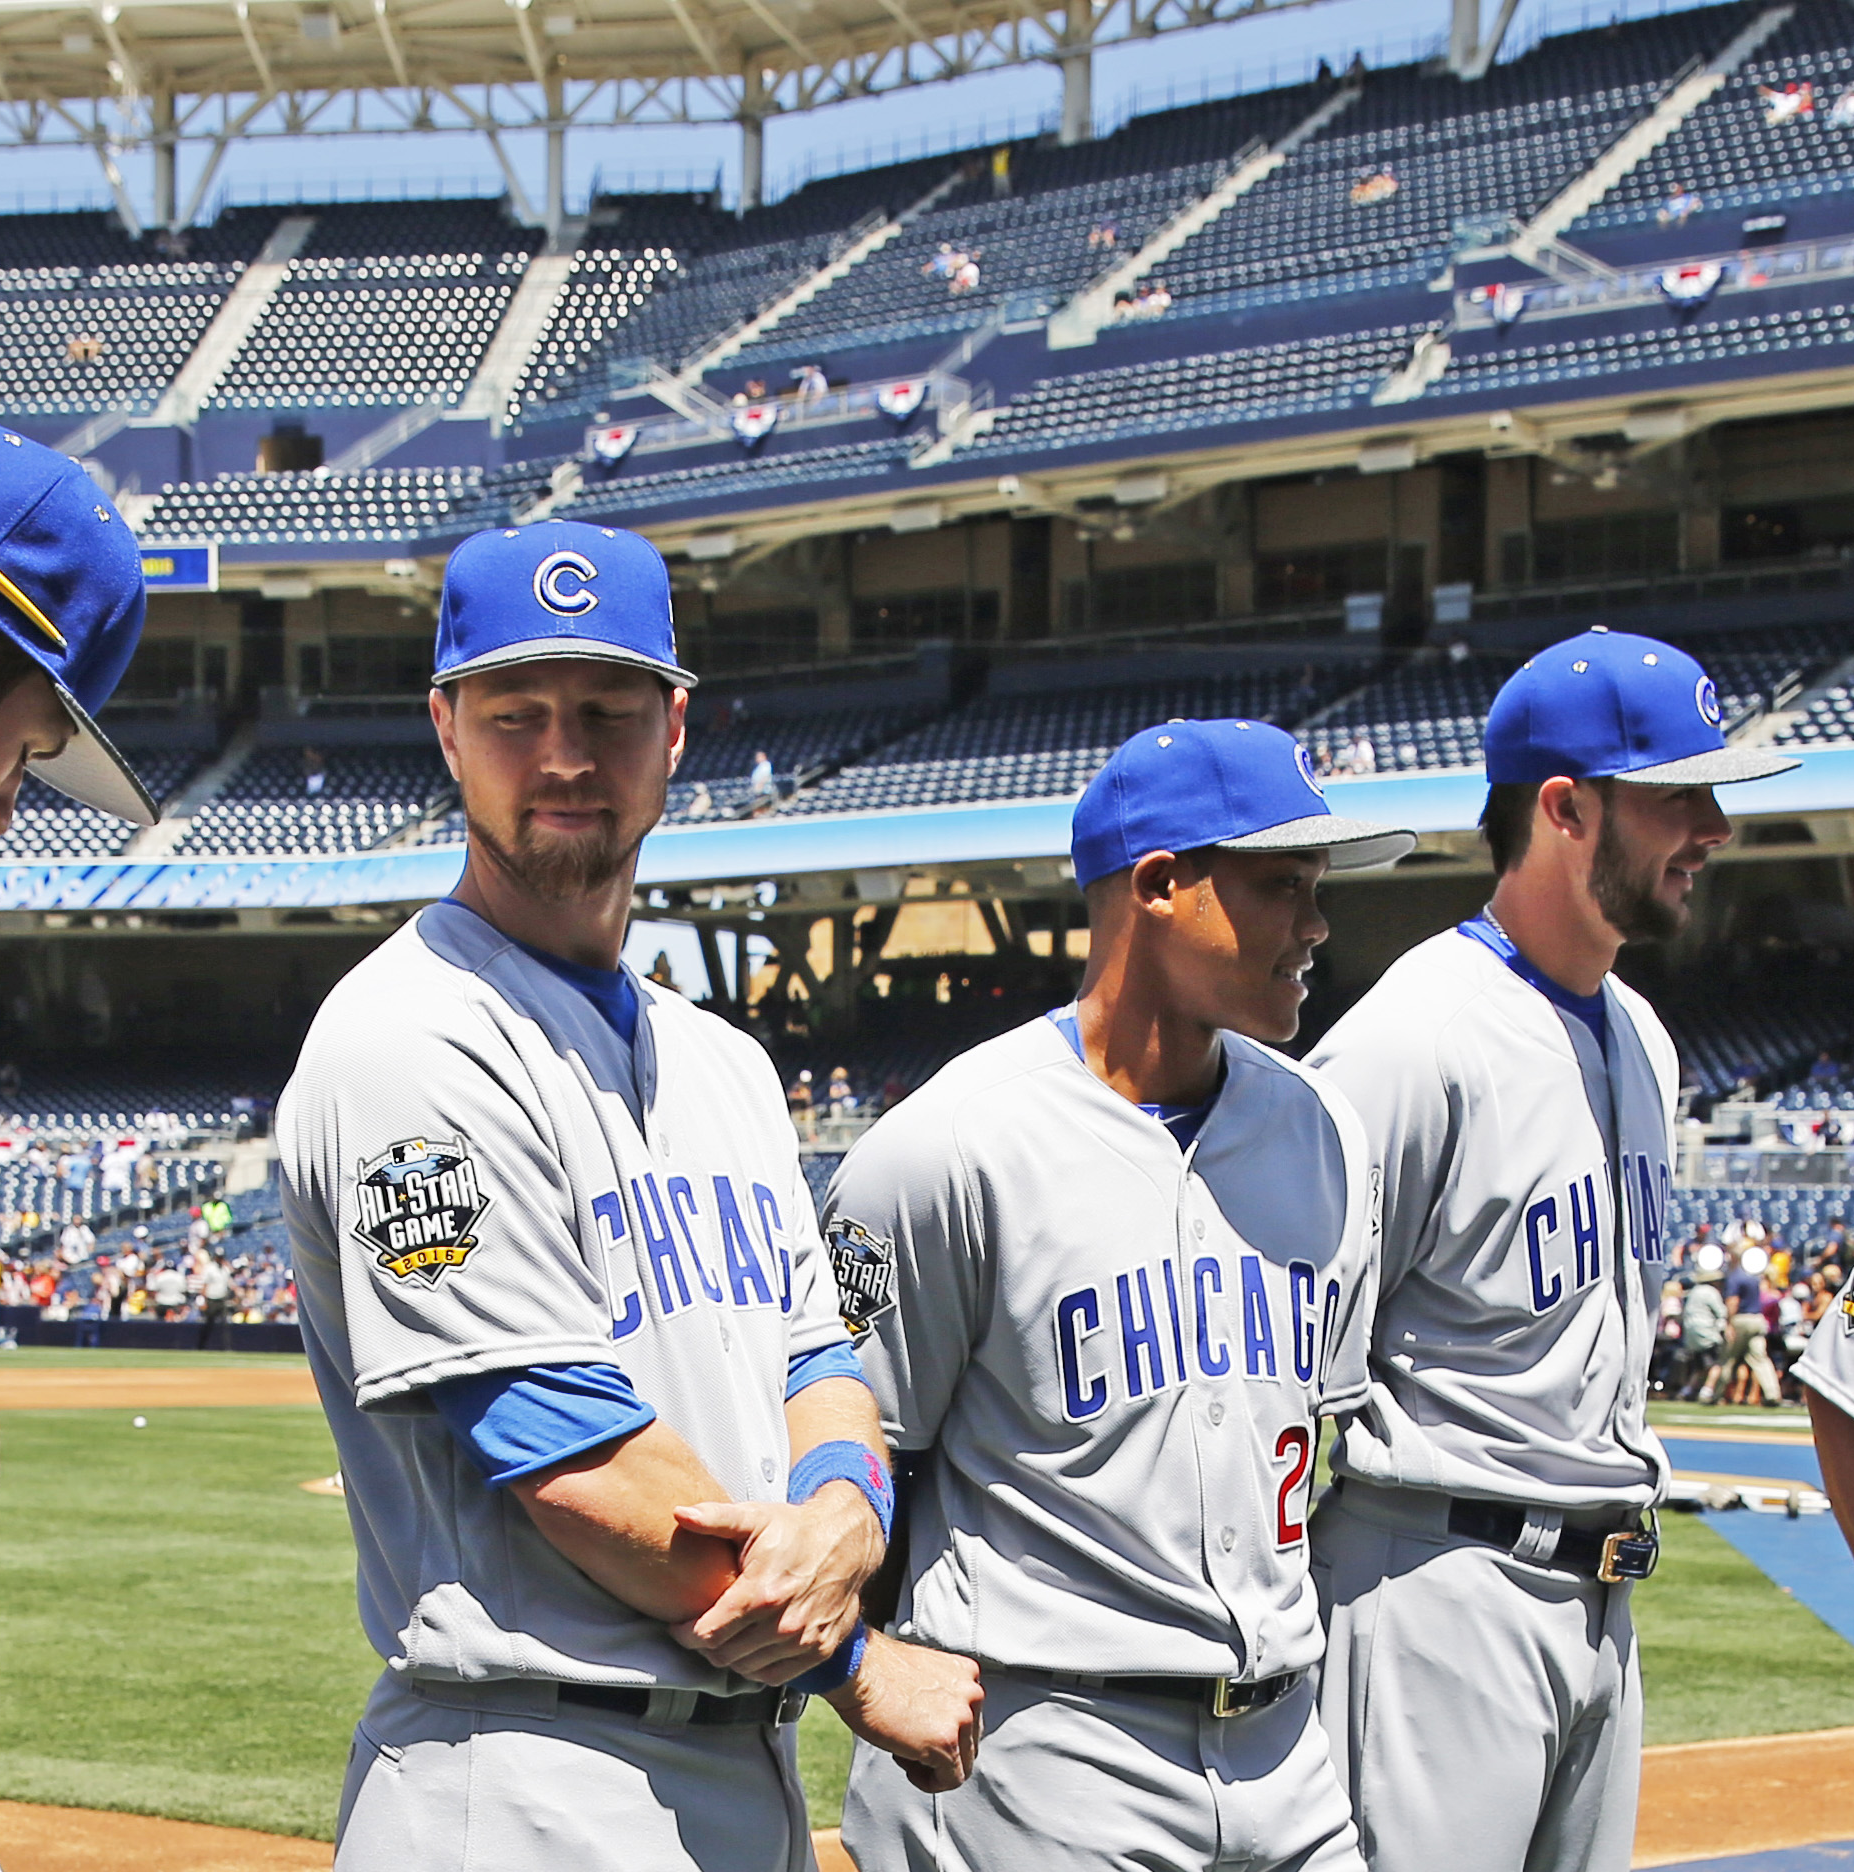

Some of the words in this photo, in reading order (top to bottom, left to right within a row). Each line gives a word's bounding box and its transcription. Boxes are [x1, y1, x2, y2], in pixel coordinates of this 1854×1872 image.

[532, 551, 599, 617] C
[357, 1183, 405, 1234] ALL
[405, 1158, 481, 1216] STAR
[388, 1209, 459, 1250] GAME
[403, 1249, 454, 1271] 2016
[837, 1247, 889, 1306] STAR
[1056, 1255, 1341, 1420] CHICAGO
[1275, 1425, 1309, 1546] 2
